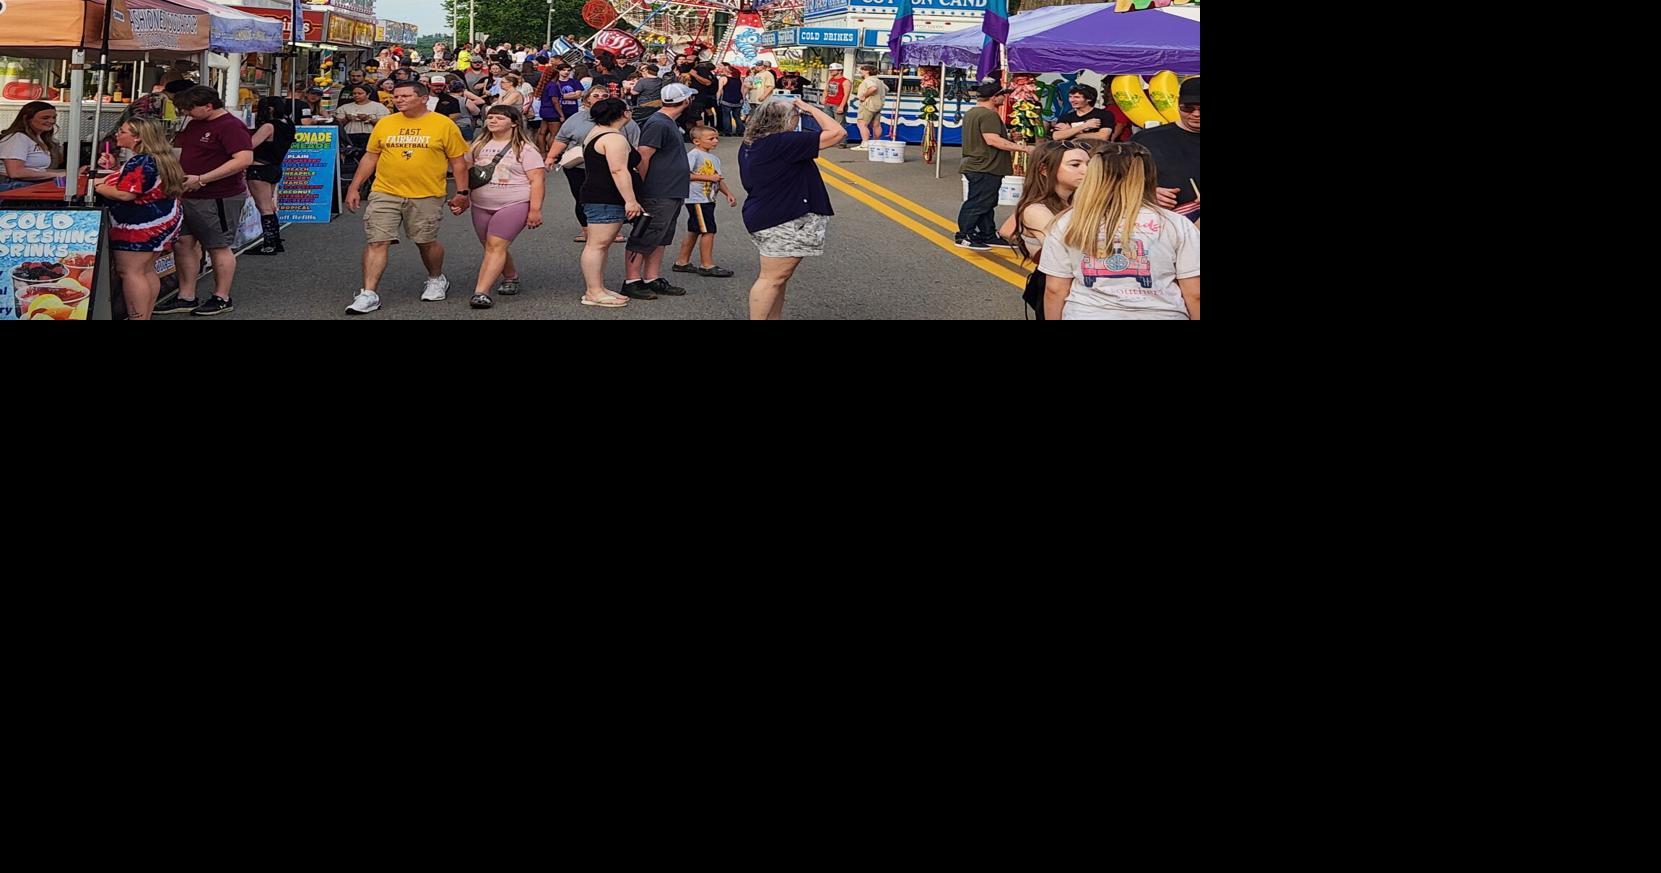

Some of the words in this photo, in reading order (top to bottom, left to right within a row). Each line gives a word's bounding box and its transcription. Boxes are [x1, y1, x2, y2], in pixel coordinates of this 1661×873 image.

[801, 31, 820, 40] COLD
[823, 32, 854, 41] DRINKS
[294, 132, 332, 142] ONADE
[386, 135, 431, 143] FAIRMONT
[0, 213, 74, 230] COLD
